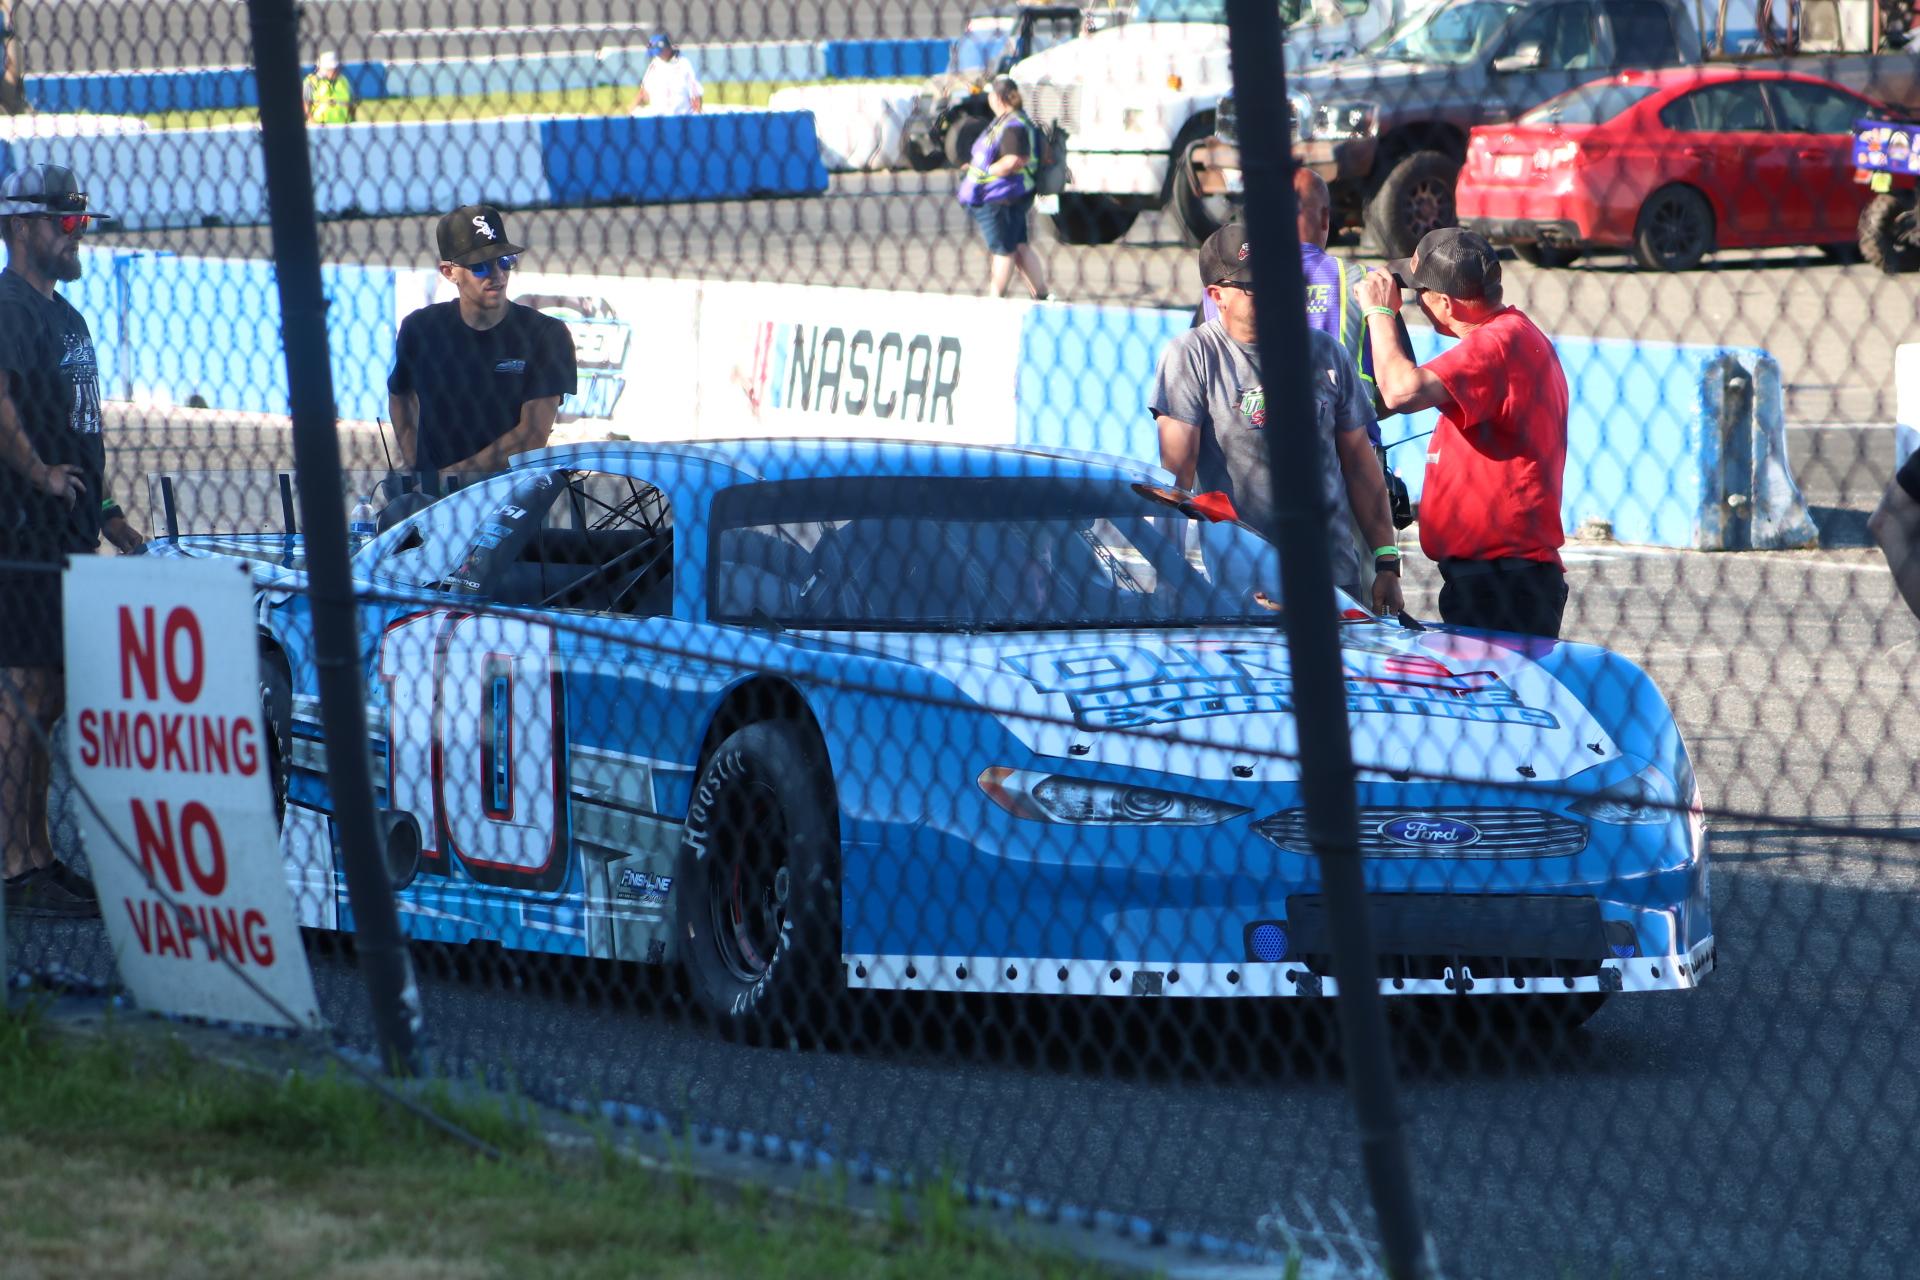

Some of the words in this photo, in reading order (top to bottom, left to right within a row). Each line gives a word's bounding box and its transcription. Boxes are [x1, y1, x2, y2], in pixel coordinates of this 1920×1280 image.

[787, 323, 962, 425] NASCAR
[119, 605, 205, 704] NO
[79, 707, 259, 778] SMOKING
[379, 606, 560, 875] 10
[130, 797, 227, 897] NO
[1404, 821, 1459, 841] Ford
[124, 897, 276, 968] VAPING
